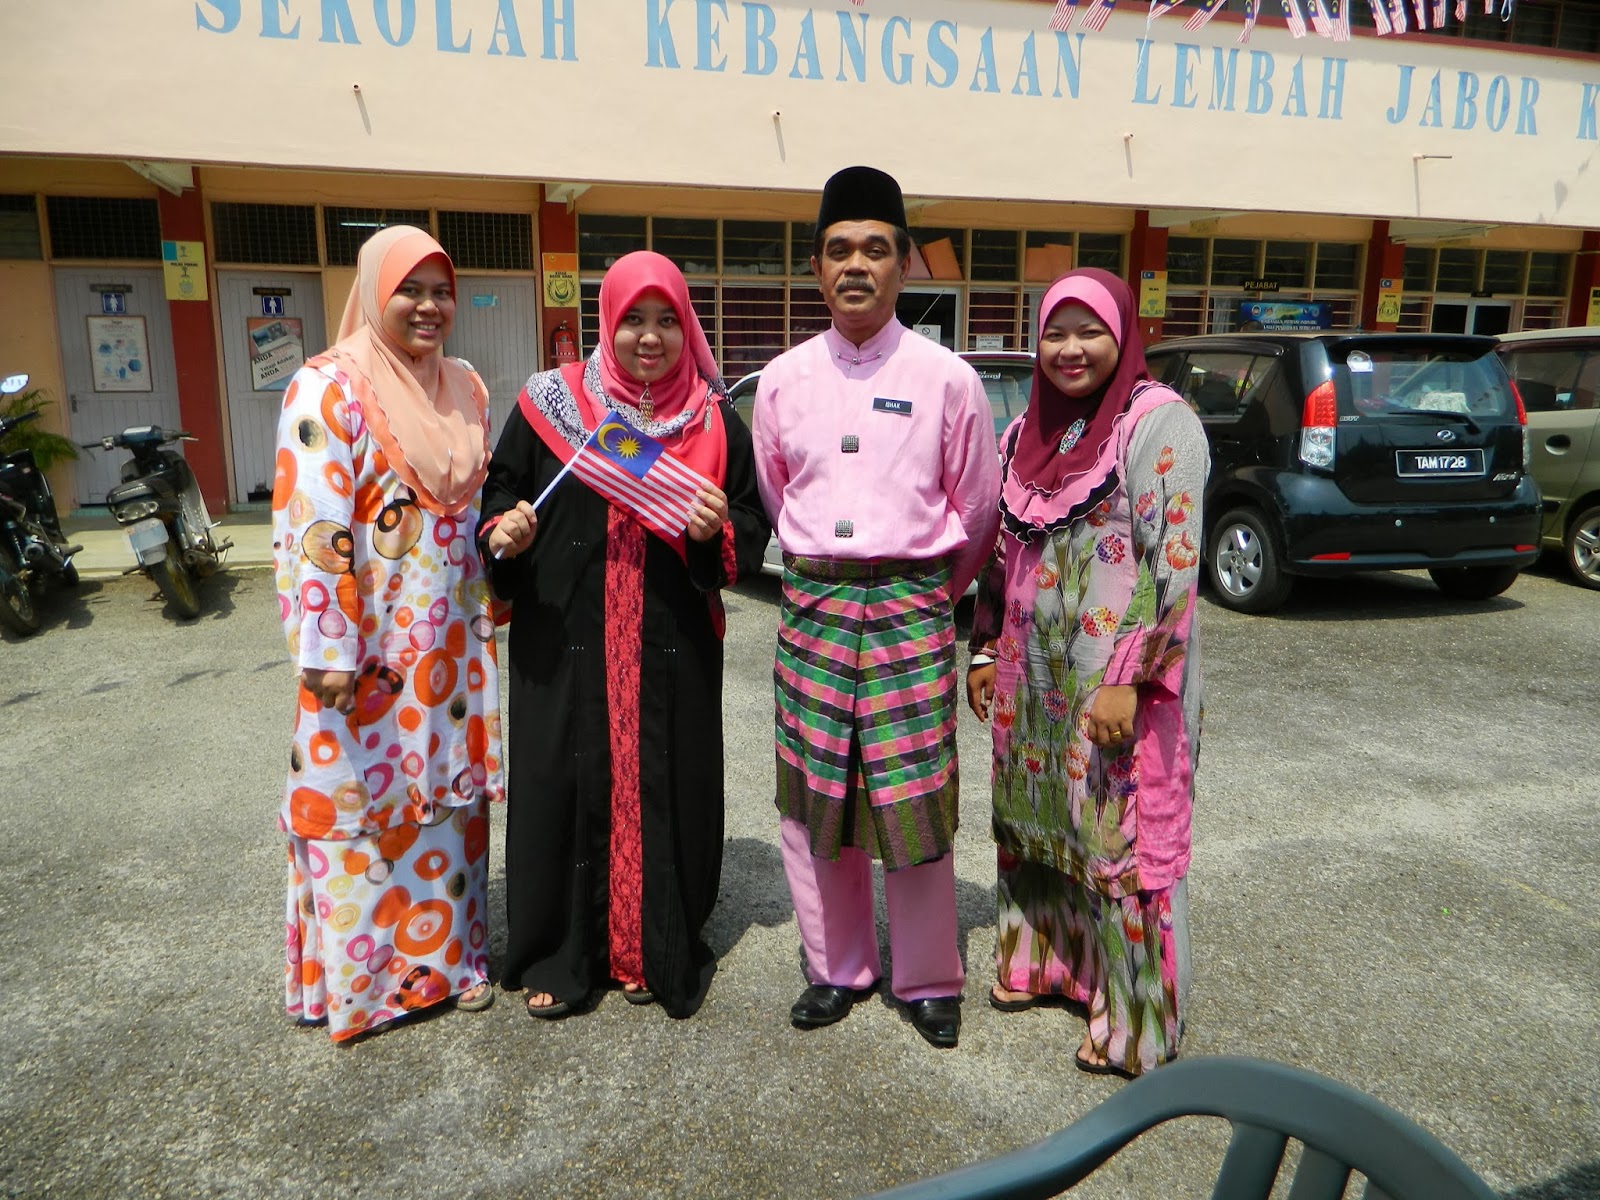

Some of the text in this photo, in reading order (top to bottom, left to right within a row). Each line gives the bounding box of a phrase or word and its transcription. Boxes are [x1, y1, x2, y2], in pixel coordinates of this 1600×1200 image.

[644, 0, 1086, 99] KEBANGSAAN
[1132, 38, 1348, 120] LEMBAH
[1387, 64, 1540, 136] JABOR
[1245, 281, 1278, 289] PEJABAT
[254, 352, 274, 365] ANDA
[260, 367, 280, 380] ANDA
[1415, 456, 1467, 470] TAM1728
